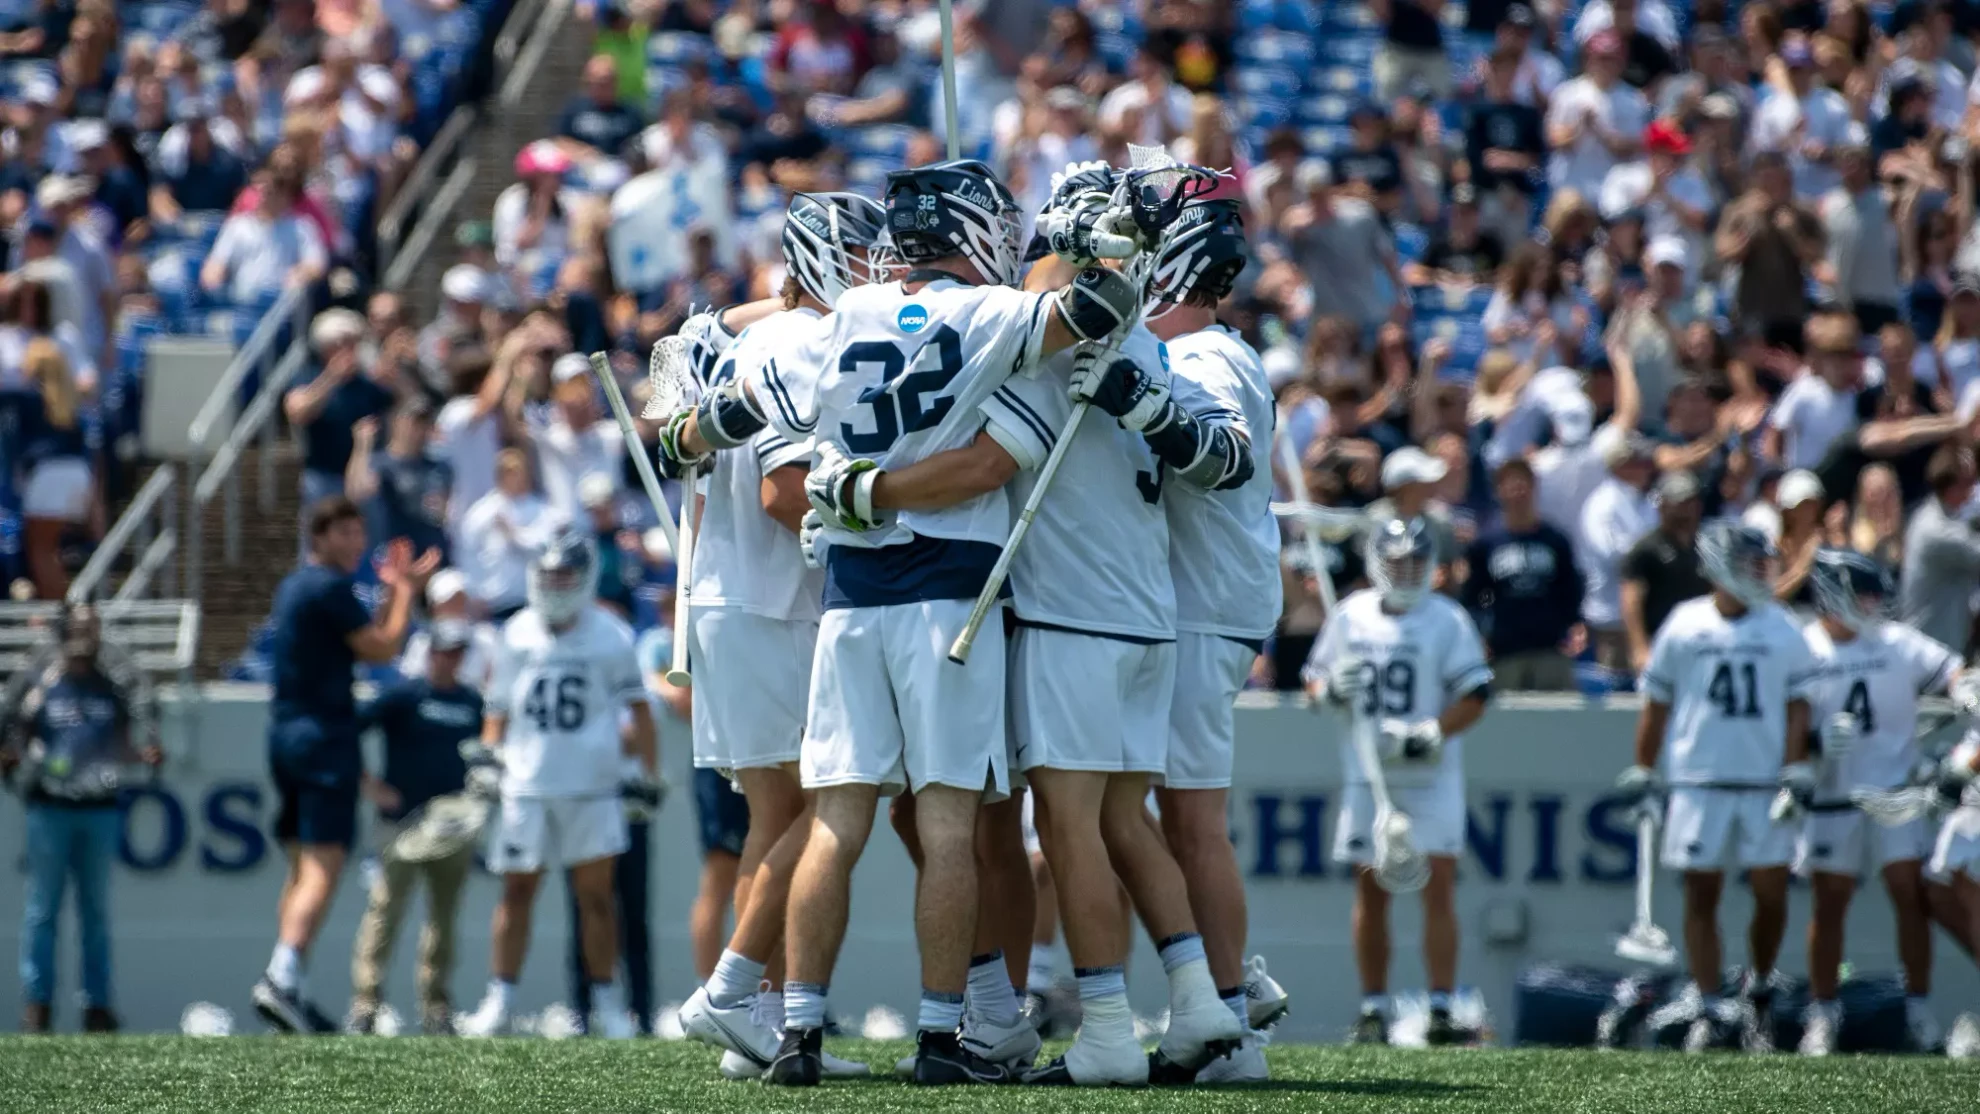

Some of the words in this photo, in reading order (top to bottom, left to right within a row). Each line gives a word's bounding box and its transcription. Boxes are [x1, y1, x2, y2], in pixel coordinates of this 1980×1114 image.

[917, 194, 937, 211] 32
[953, 177, 994, 211] Lions
[793, 202, 830, 239] Lions
[900, 315, 926, 326] NCAA
[838, 322, 963, 454] 32
[524, 675, 586, 734] 46
[1708, 662, 1762, 717] 41
[1844, 679, 1874, 735] 4
